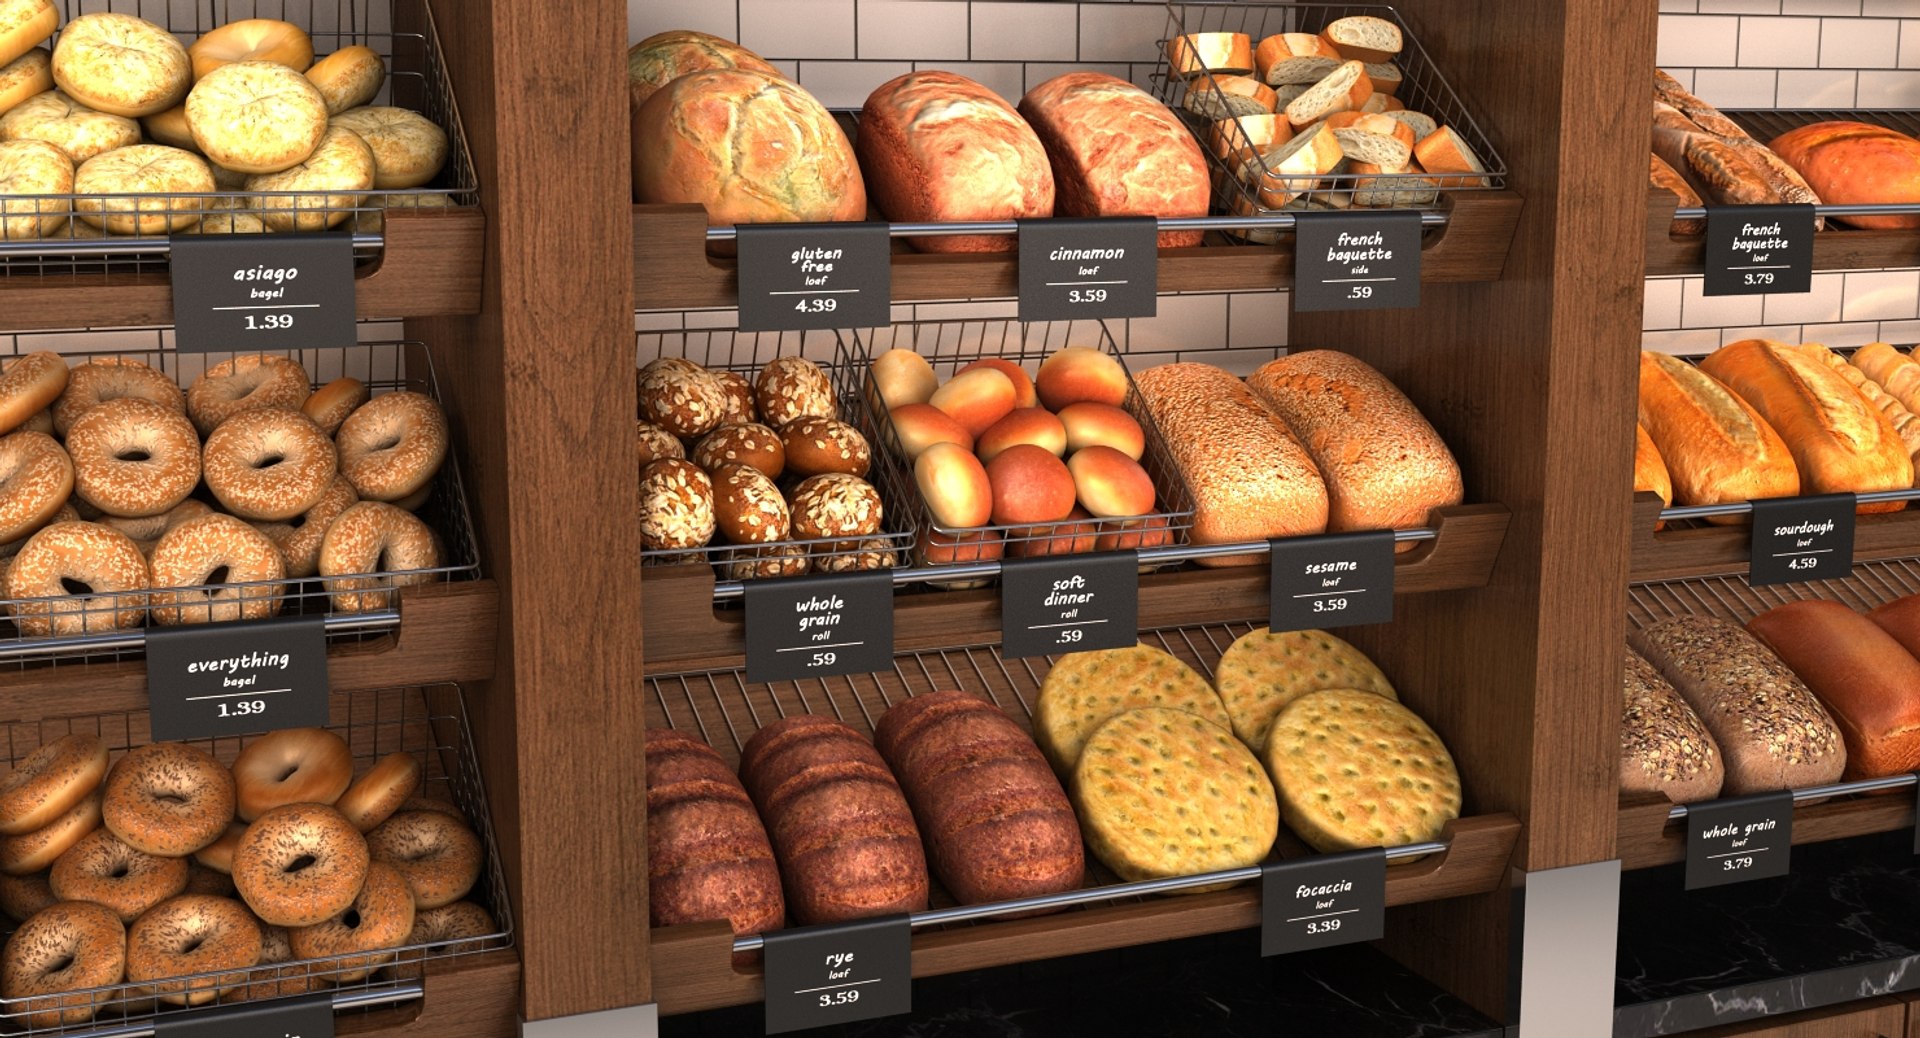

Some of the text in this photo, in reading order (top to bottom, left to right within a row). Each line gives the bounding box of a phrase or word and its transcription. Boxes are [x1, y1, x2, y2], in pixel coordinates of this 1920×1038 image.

[1740, 221, 1782, 237] french
[1337, 230, 1384, 247] french
[1731, 237, 1789, 254] baguette
[791, 246, 843, 263] gluten
[1049, 245, 1125, 262] cinnamon
[1326, 246, 1393, 265] baguette
[1752, 253, 1770, 263] loaf
[801, 260, 834, 274] free
[1077, 265, 1101, 277] loaf
[1350, 264, 1369, 275] side
[233, 264, 299, 286] asiago
[804, 274, 829, 287] loaf
[1743, 272, 1775, 286] 3.79
[250, 286, 285, 301] bagel
[1069, 289, 1108, 304] 3.59
[1346, 285, 1373, 300] .59
[795, 298, 837, 313] 4.39
[244, 313, 294, 330] 1.39
[1773, 518, 1835, 537] sourdough
[1796, 537, 1814, 548] loaf
[1304, 561, 1358, 575] sesame
[1788, 557, 1818, 570] 4.59
[1052, 574, 1086, 592] soft
[1321, 576, 1342, 588] loaf
[795, 593, 845, 613] whole
[1043, 588, 1095, 607] dinner
[1312, 597, 1348, 613] 3.59
[798, 610, 841, 632] grain
[1060, 608, 1079, 619] roll
[811, 630, 832, 641] roll
[1055, 629, 1084, 644] .59
[187, 650, 290, 675] everything
[806, 652, 837, 667] .59
[222, 674, 257, 689] bagel
[217, 699, 266, 718] 1.39
[1702, 818, 1777, 840] whole grain
[1731, 837, 1749, 848] loaf
[1723, 856, 1753, 871] 3.79
[1295, 879, 1353, 899] focaccia
[1315, 898, 1335, 910] loaf
[1306, 918, 1342, 935] 3.39
[825, 952, 855, 968] rye
[828, 967, 852, 980] loaf
[819, 989, 860, 1007] 3.59
